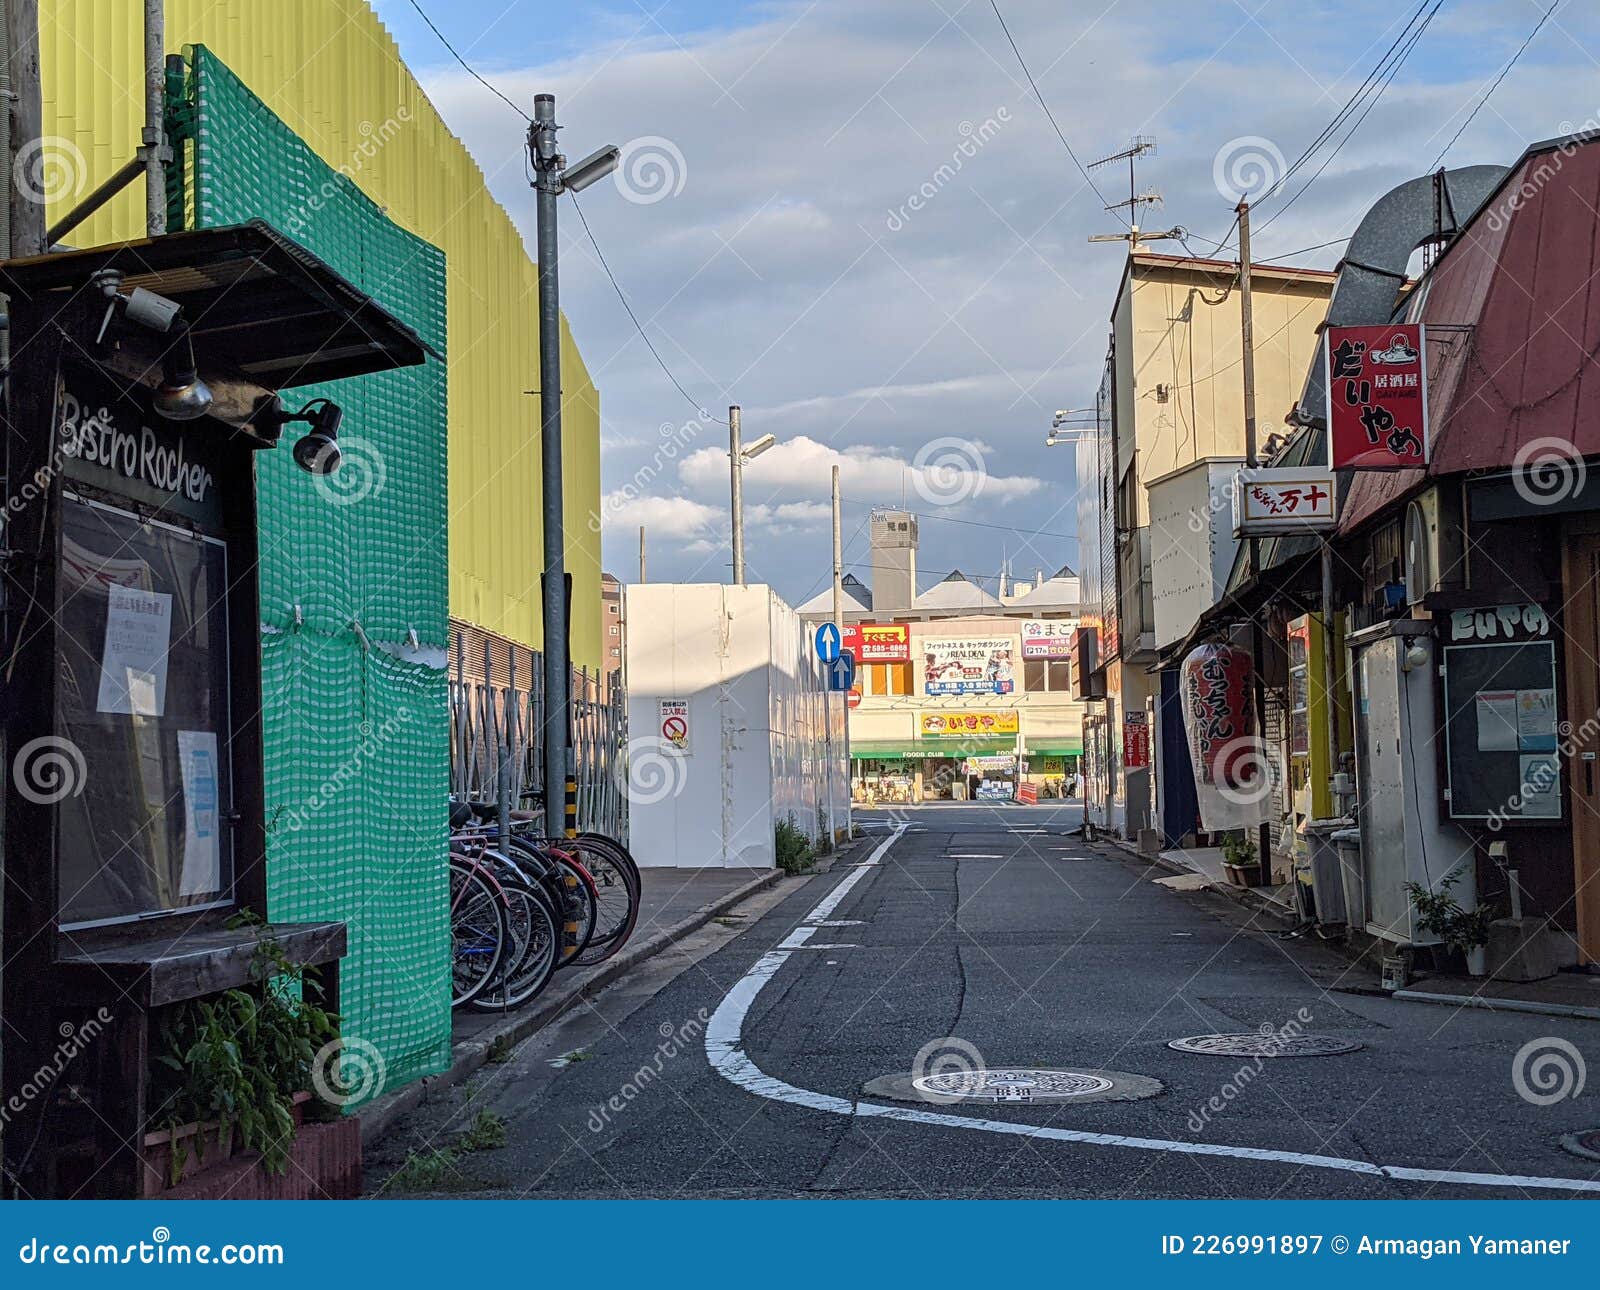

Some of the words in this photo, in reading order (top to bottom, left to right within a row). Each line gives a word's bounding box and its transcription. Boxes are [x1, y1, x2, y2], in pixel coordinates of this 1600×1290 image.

[1375, 373, 1418, 388] 居酒屋
[1332, 338, 1422, 457] だいやめ
[63, 392, 137, 478] Bistro
[141, 425, 213, 502] Rocher
[662, 708, 688, 716] 立入禁止
[949, 715, 995, 730] いせや
